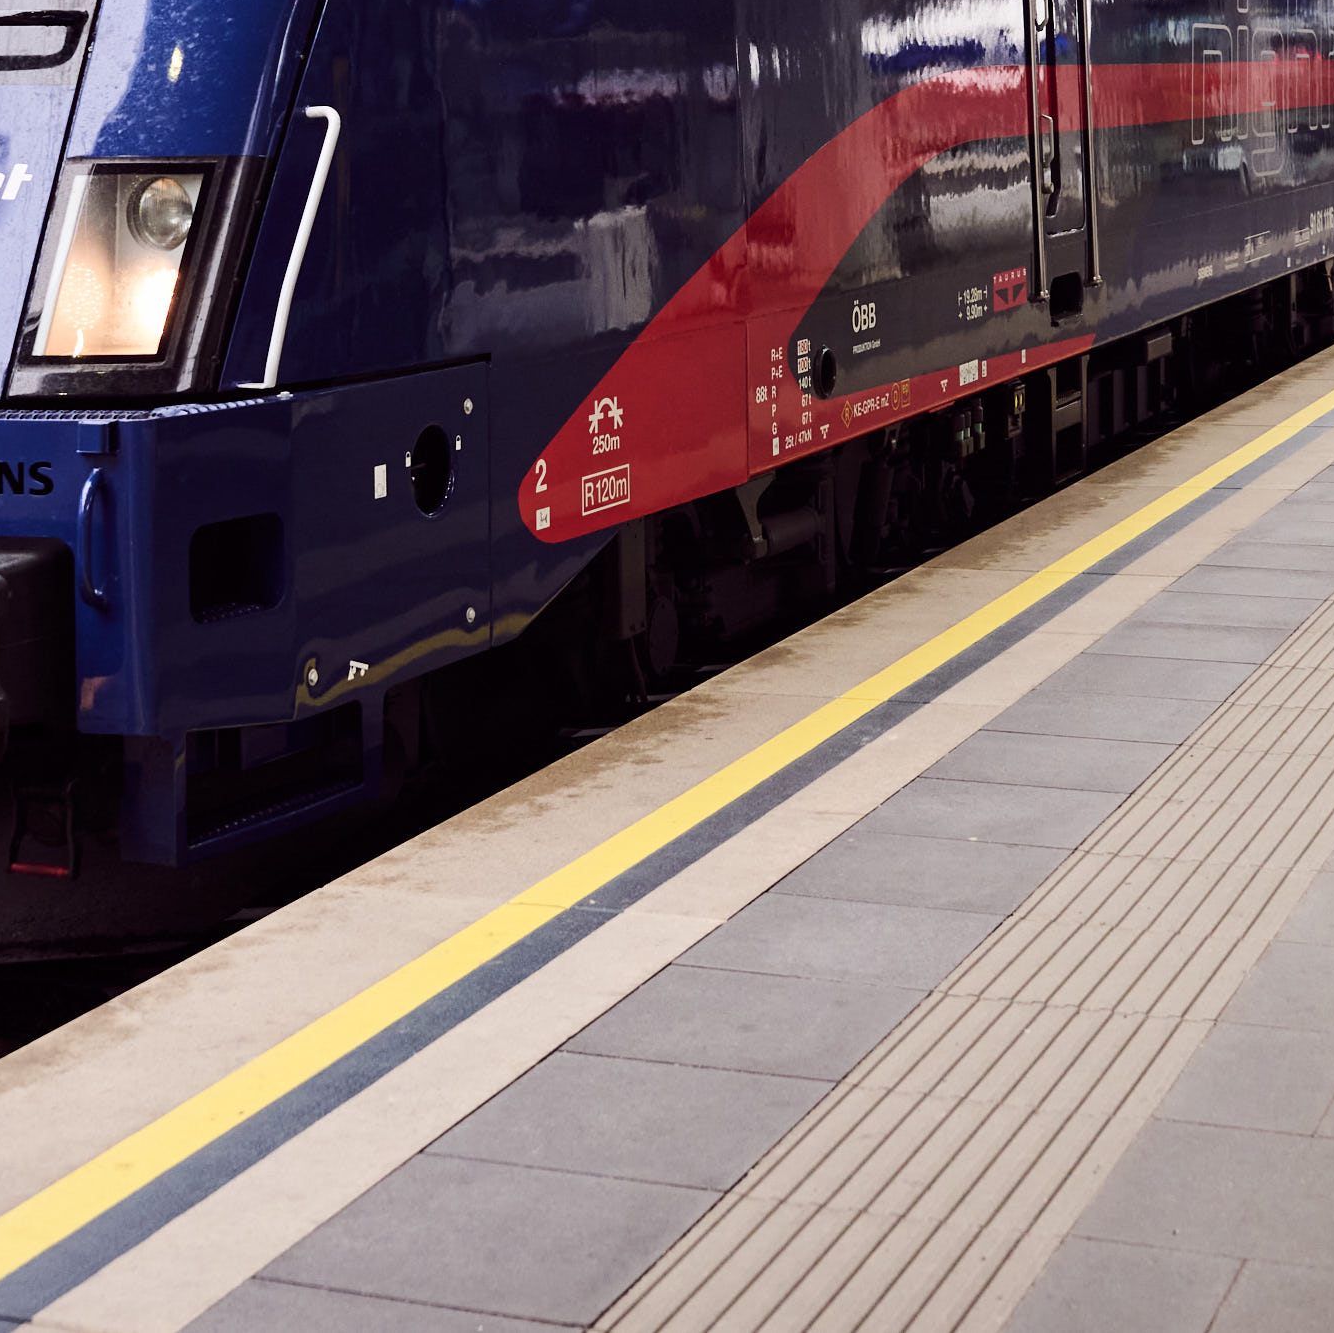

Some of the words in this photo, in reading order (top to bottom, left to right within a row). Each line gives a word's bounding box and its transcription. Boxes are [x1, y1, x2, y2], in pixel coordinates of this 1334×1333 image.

[993, 267, 1027, 284] TAURUS
[852, 299, 877, 333] ÖBB
[771, 346, 783, 362] R+E
[771, 365, 783, 380] P+E
[755, 385, 768, 404] 88t
[771, 385, 777, 399] R
[771, 403, 777, 417] P
[853, 395, 880, 418] KE-GPR-E
[880, 392, 890, 408] mZ
[771, 421, 777, 435] G
[592, 433, 620, 456] 250m
[534, 458, 548, 494] 2
[585, 481, 595, 508] R
[595, 475, 627, 504] 120m
